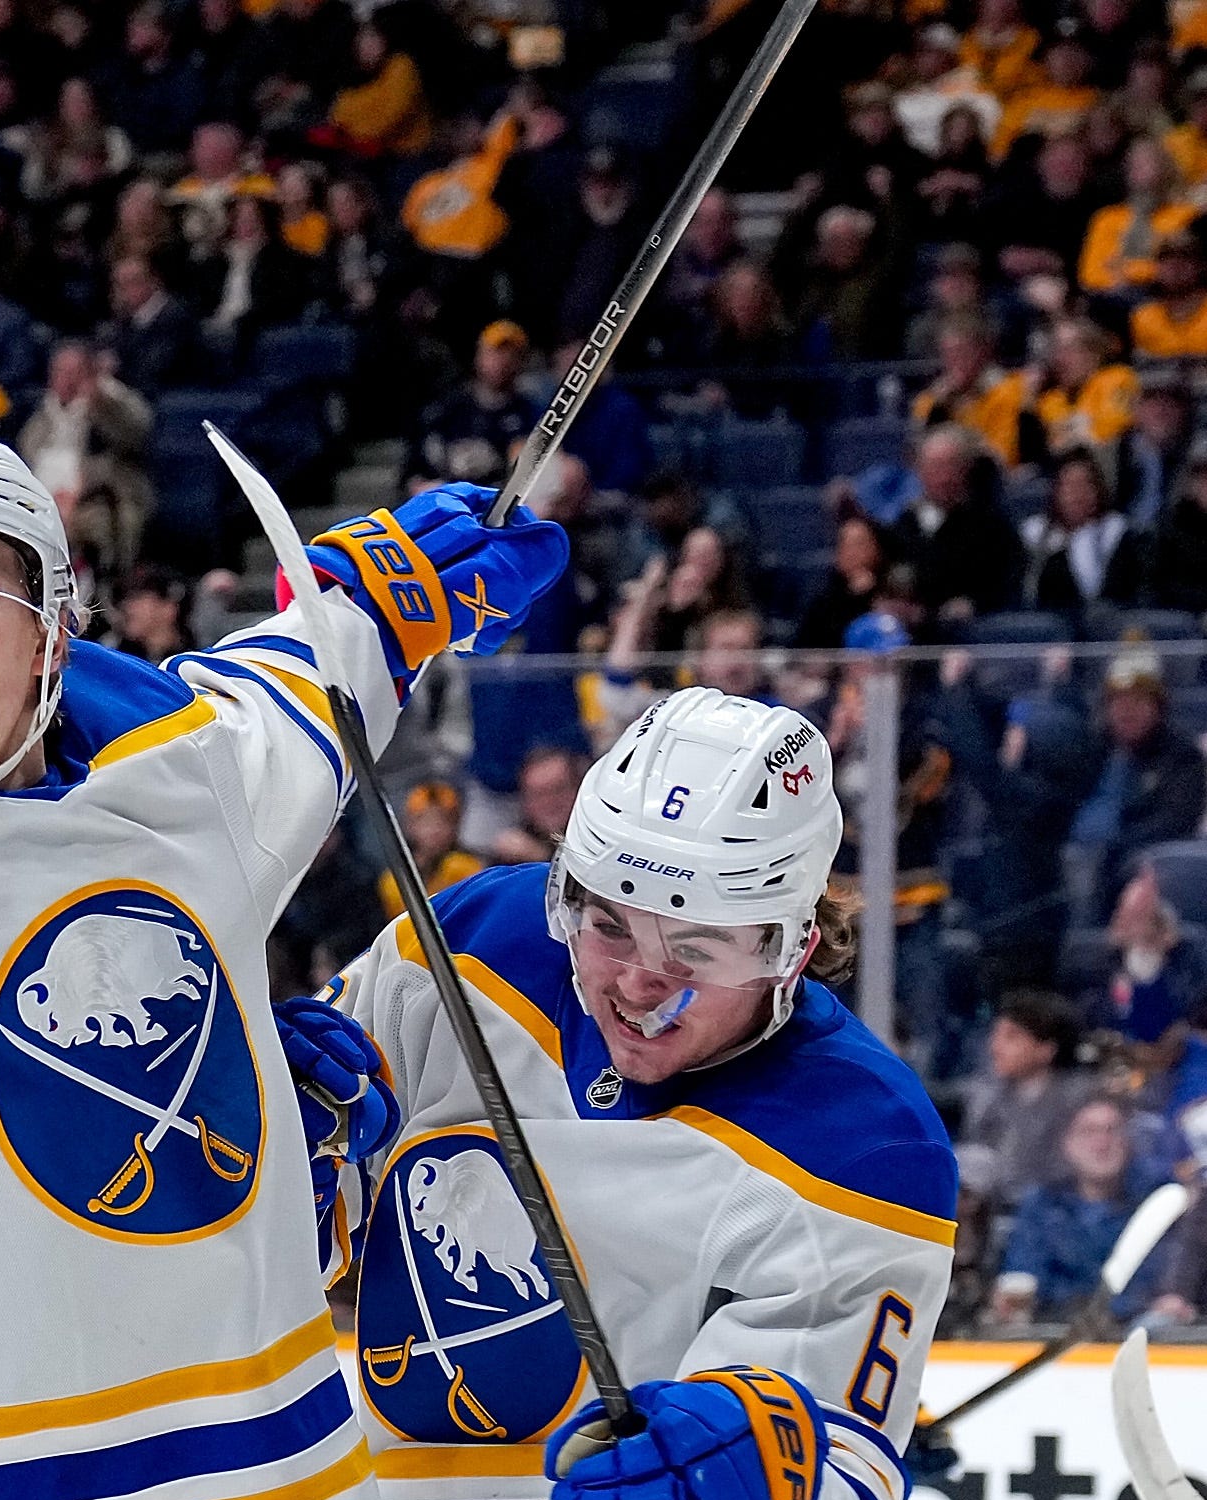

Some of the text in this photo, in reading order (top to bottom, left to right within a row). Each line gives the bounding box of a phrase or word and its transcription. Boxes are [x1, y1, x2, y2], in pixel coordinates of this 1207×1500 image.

[539, 300, 626, 436] RIBCOR
[763, 721, 816, 775] KeyBank
[661, 785, 690, 821] 6
[616, 852, 696, 882] BAUER
[845, 1289, 913, 1430] 6
